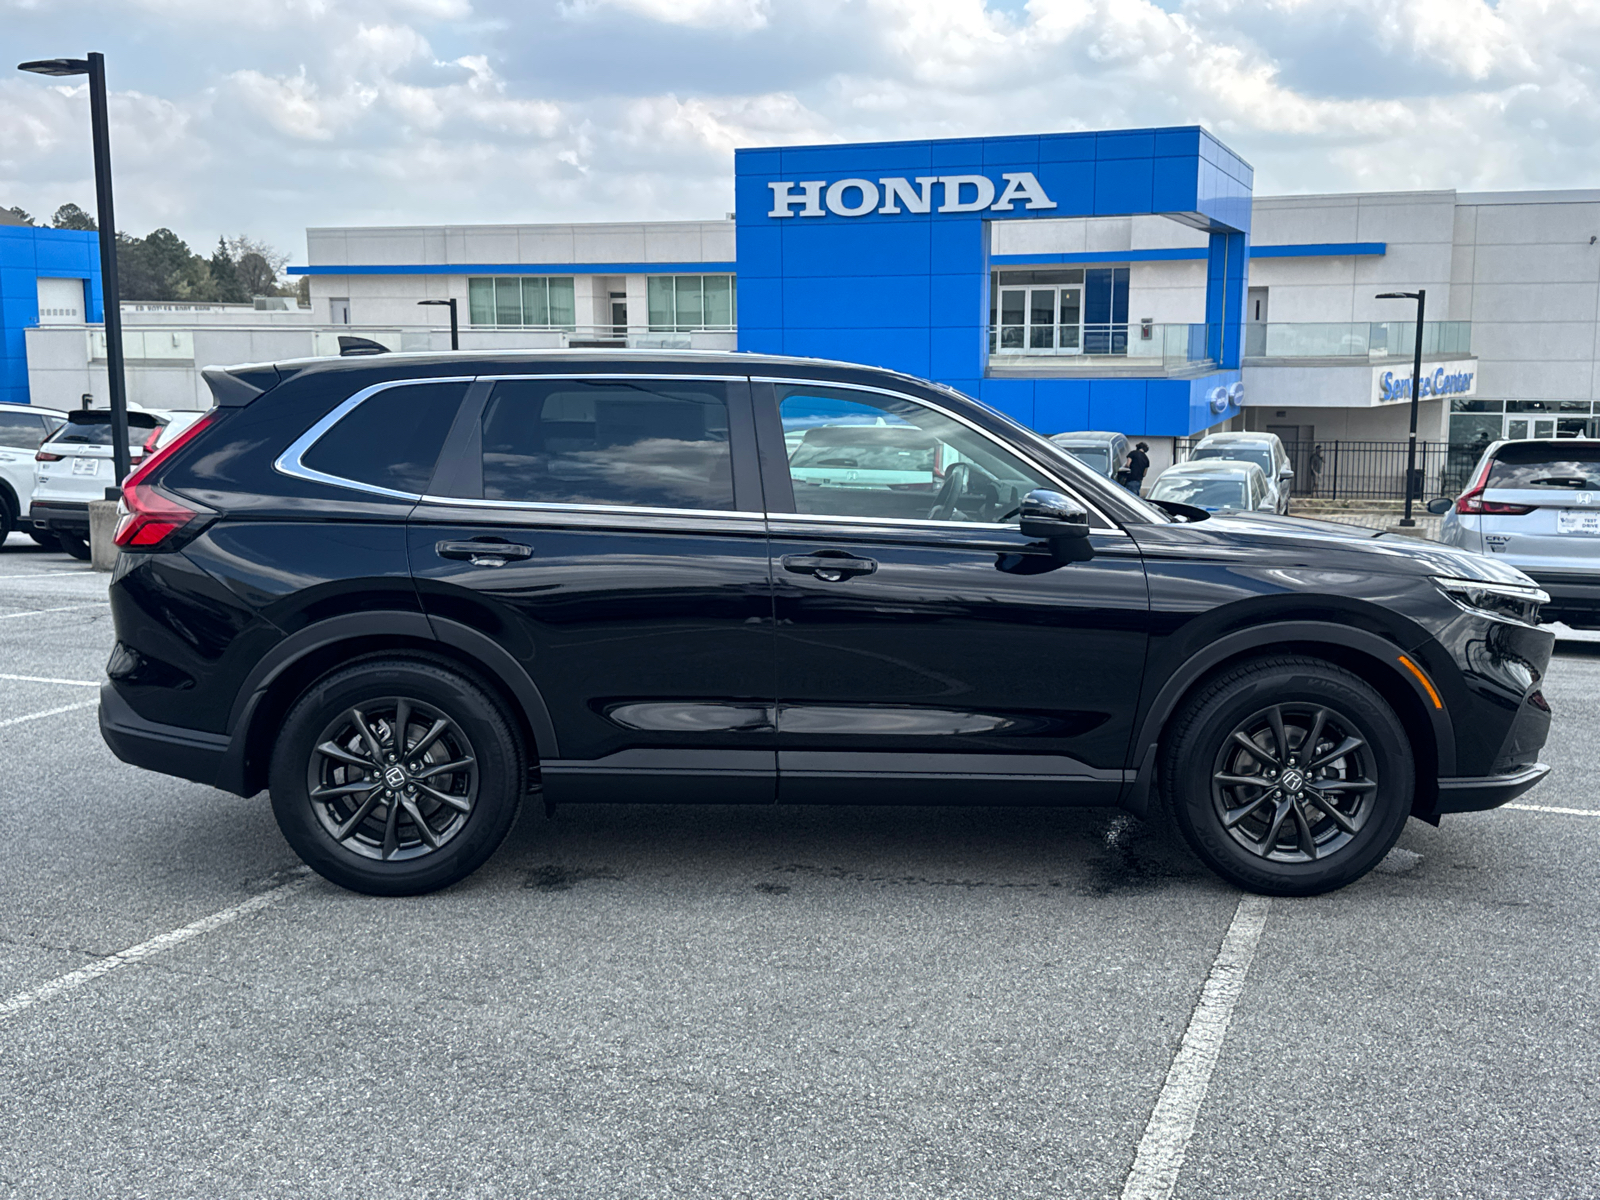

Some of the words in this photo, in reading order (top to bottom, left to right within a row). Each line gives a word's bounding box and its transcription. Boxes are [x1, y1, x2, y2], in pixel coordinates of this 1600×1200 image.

[768, 172, 1057, 217] HONDA
[1383, 371, 1431, 400] Servce
[1433, 367, 1474, 395] Center
